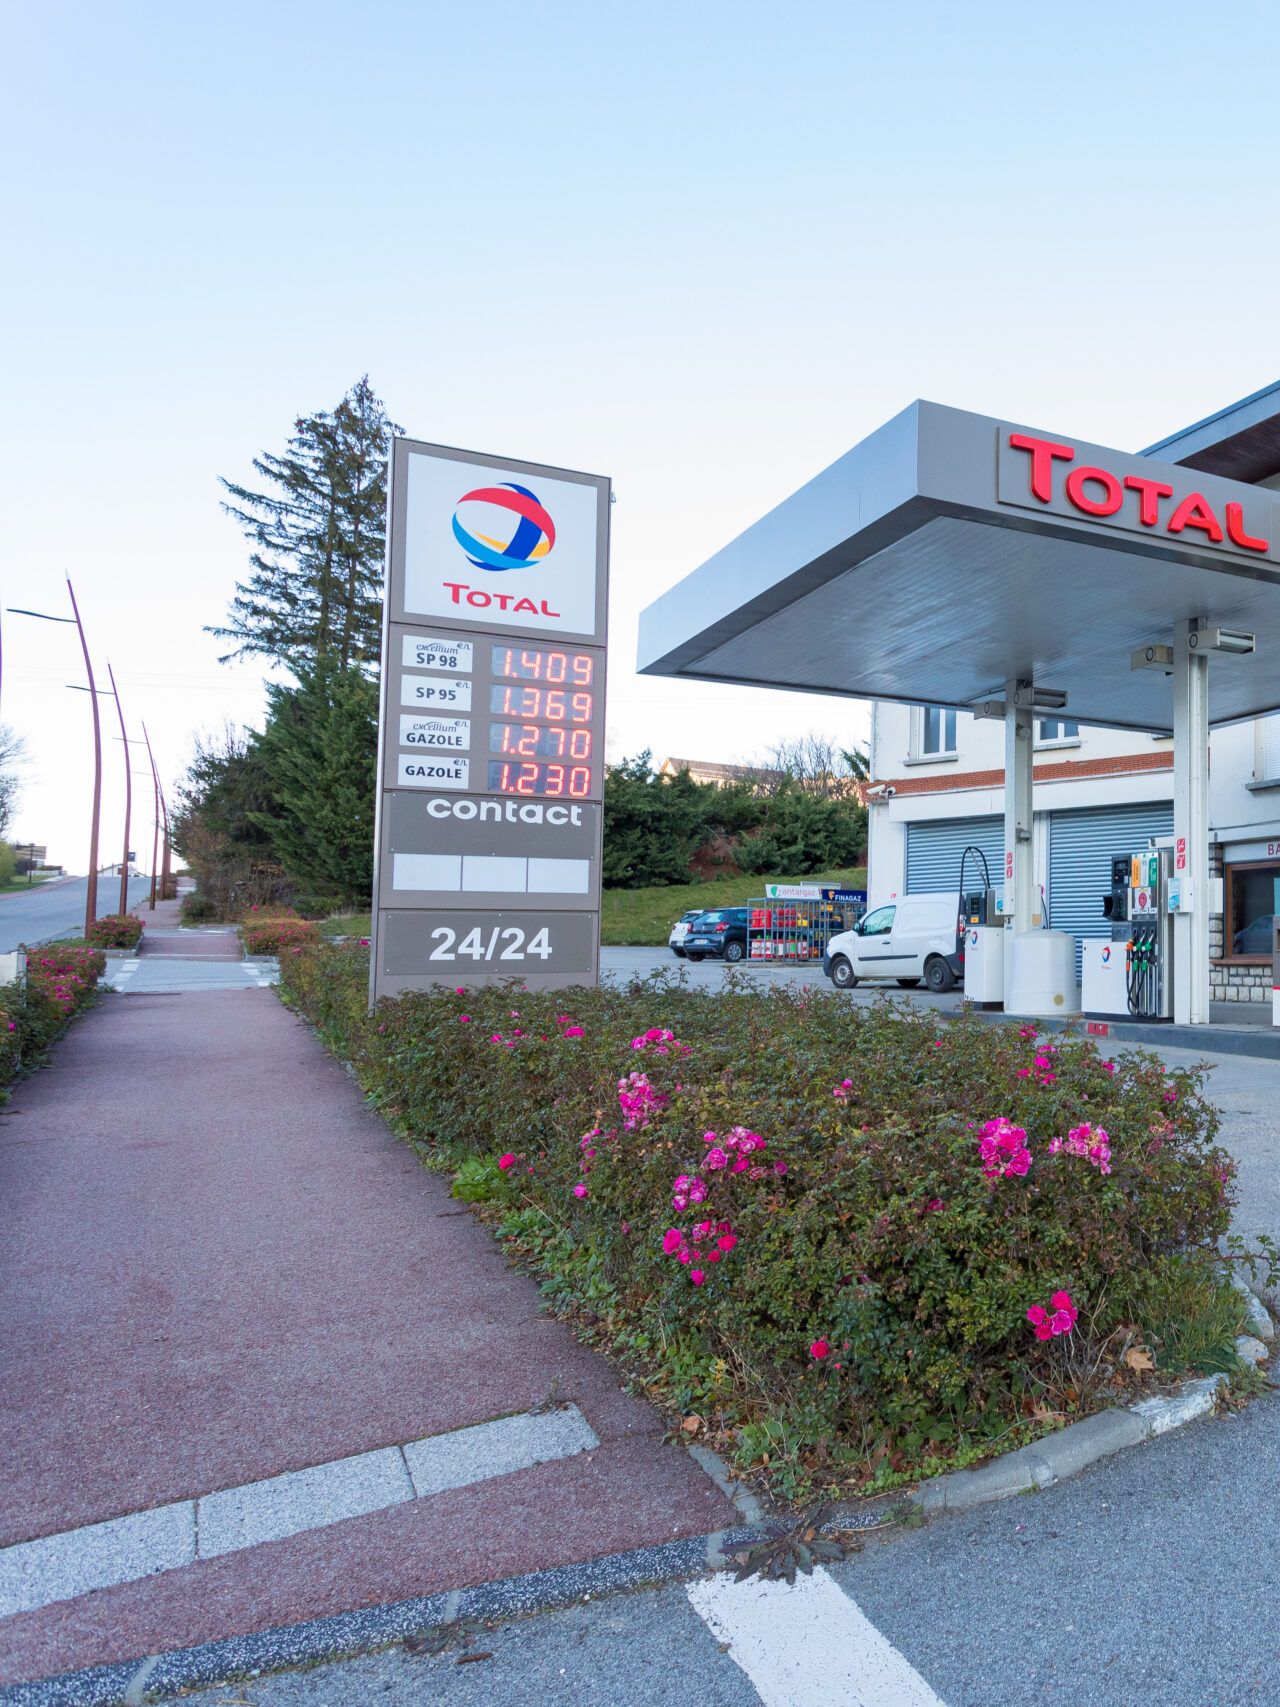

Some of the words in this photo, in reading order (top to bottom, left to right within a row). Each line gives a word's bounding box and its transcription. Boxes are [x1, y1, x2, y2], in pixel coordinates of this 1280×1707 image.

[1009, 433, 1269, 552] TOTAL
[442, 582, 561, 618] TOTAL
[415, 642, 459, 655] excellium
[456, 642, 472, 651] €/L
[416, 652, 436, 665] SP
[439, 655, 458, 668] 98
[504, 648, 593, 686] 1.409
[455, 681, 470, 689] €/L
[416, 686, 435, 699] SP
[439, 689, 457, 701] 95
[503, 687, 592, 722] 1.369
[412, 721, 457, 734] excellium
[454, 719, 469, 728] €/L
[406, 732, 463, 747] GAZOLE
[502, 725, 591, 759] 1.270
[453, 758, 468, 767] €/L
[405, 765, 462, 779] GAZOLE
[501, 763, 590, 796] 1.230
[427, 798, 582, 827] contact
[782, 888, 815, 897] antargaz
[834, 894, 862, 902] FINAGAZ
[429, 927, 553, 960] 24/24
